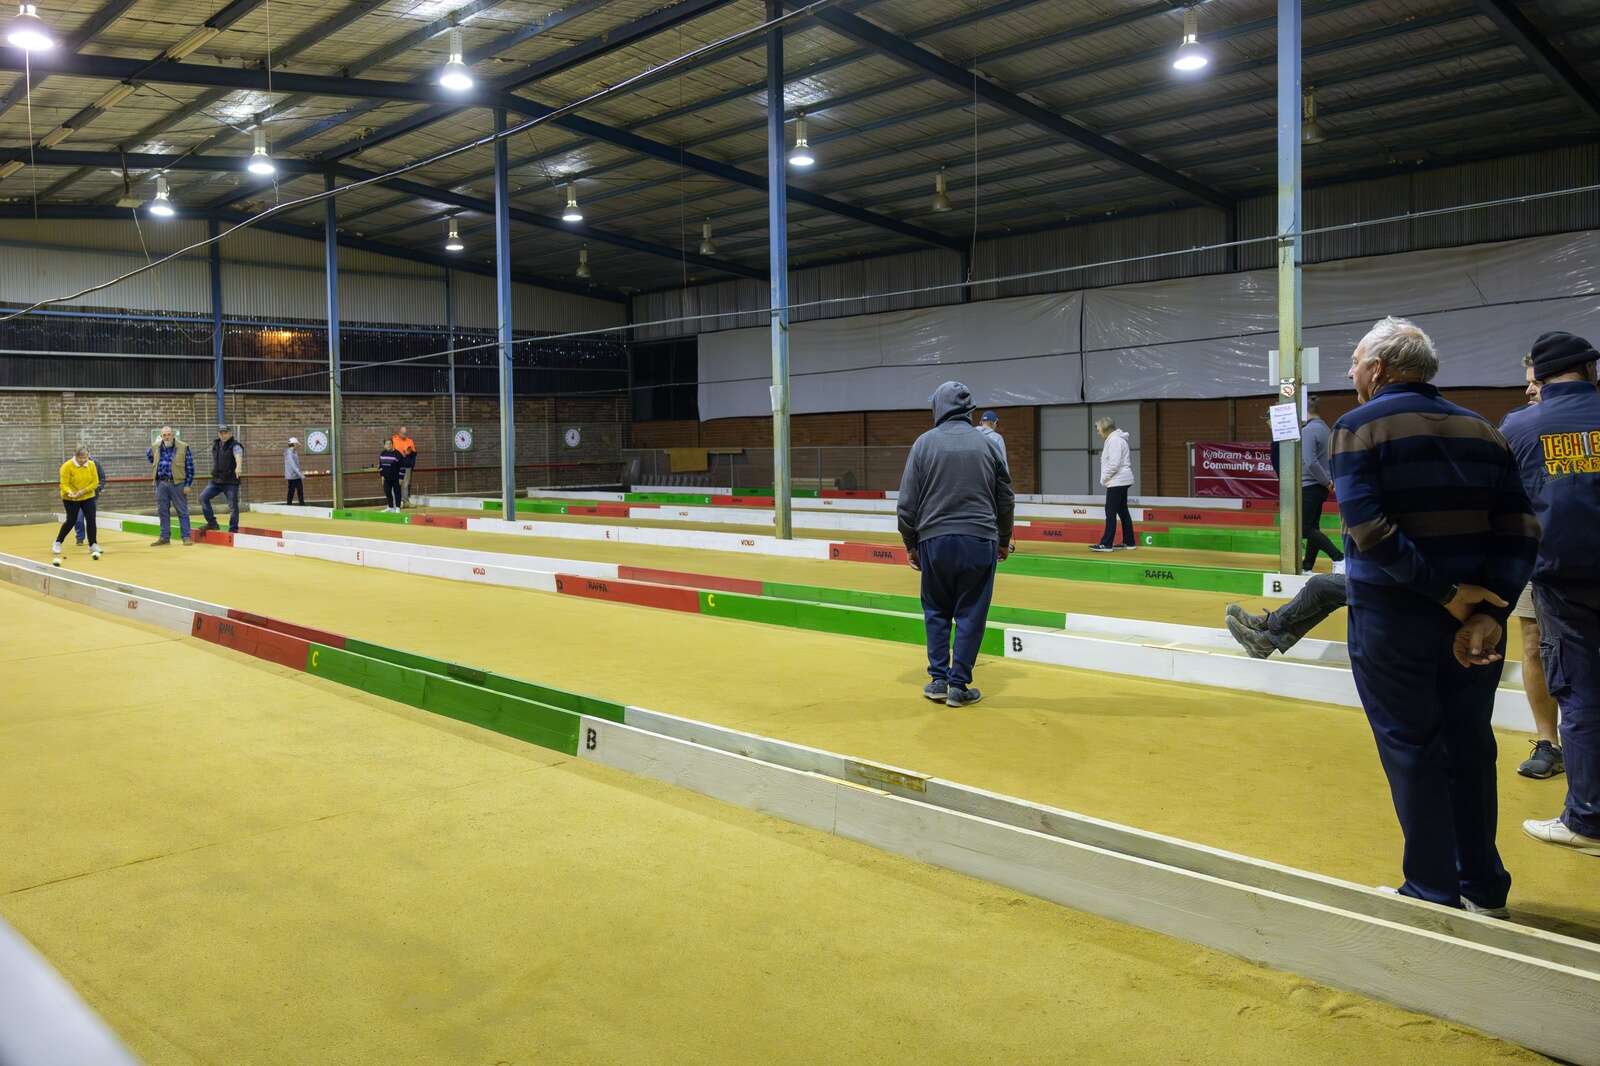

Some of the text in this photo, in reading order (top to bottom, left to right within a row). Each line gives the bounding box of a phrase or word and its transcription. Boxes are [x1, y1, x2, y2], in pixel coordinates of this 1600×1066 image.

[1203, 449, 1242, 460] Kyabram
[1244, 452, 1253, 460] &
[1203, 460, 1255, 472] Community
[741, 539, 755, 547] VOLO
[1145, 536, 1153, 545] C
[833, 548, 839, 558] D
[873, 550, 893, 559] RAFFA
[472, 567, 486, 576] VOLO
[1145, 570, 1174, 580] RAFFA
[1272, 580, 1282, 593] B
[707, 593, 716, 608] C
[1012, 636, 1023, 652] B
[311, 650, 320, 668] C
[586, 727, 597, 751] B
